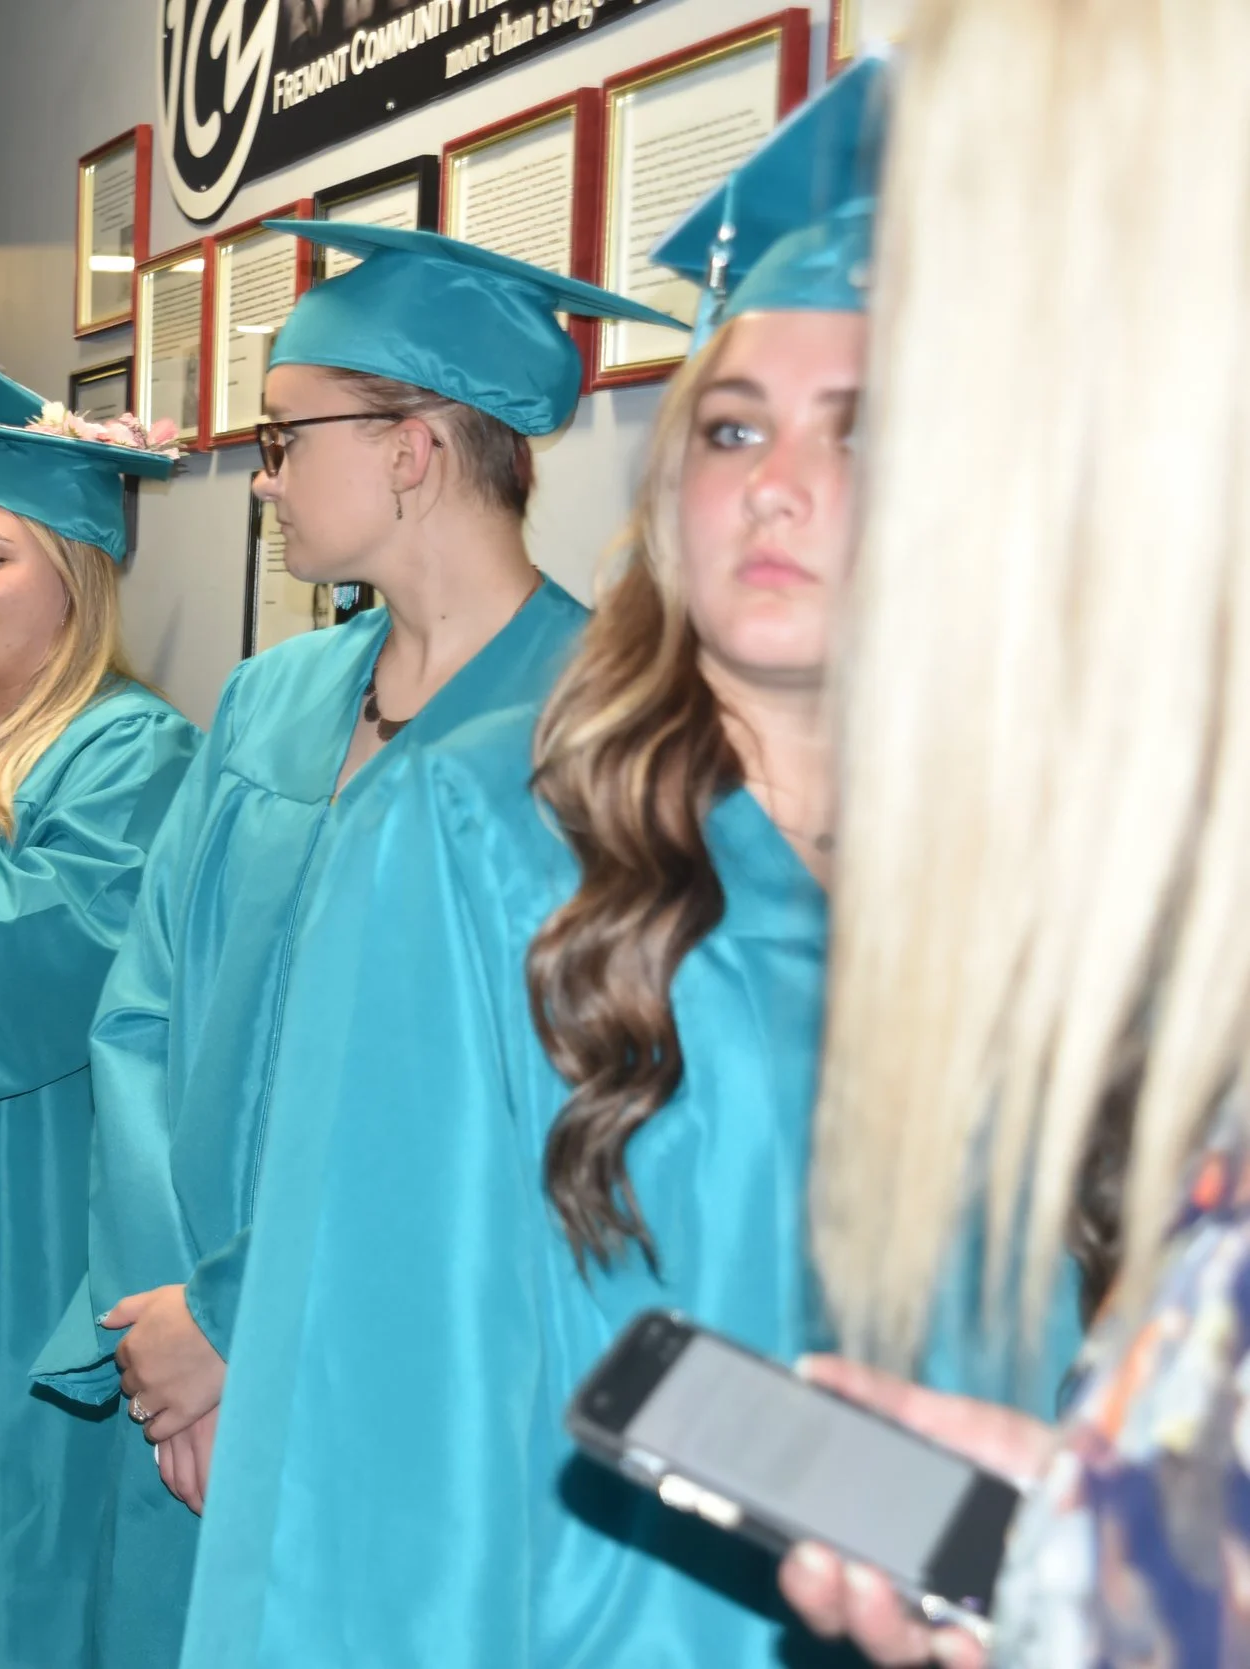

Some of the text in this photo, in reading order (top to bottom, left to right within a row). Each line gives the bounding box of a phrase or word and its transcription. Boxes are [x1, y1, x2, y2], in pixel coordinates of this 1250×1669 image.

[272, 45, 349, 114] FREMONT
[350, 0, 464, 75] COMMUNITY
[445, 35, 490, 79] more
[492, 12, 534, 56] than
[536, 7, 549, 35] a
